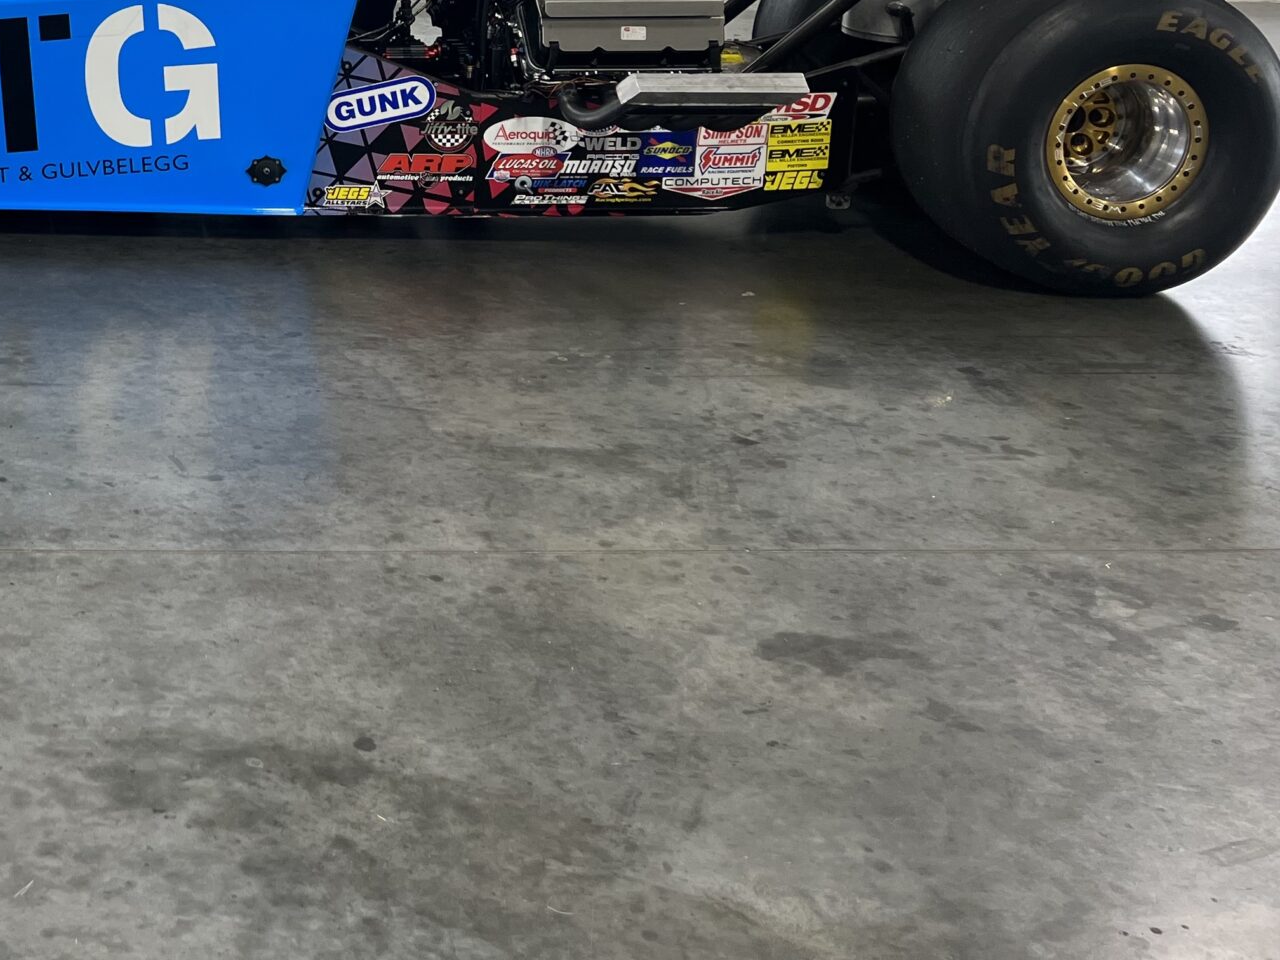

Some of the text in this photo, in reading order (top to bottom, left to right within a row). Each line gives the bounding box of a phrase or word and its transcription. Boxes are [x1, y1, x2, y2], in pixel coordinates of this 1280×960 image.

[1156, 10, 1262, 83] EAGLE
[334, 86, 423, 122] GUNK
[421, 123, 479, 135] Jiffy-tite
[494, 123, 557, 142] Aeroquip
[702, 125, 764, 139] SIMPSON
[770, 122, 819, 134] BME
[585, 137, 642, 151] WELD
[644, 145, 691, 155] SUNOCO
[535, 147, 554, 156] NHRA
[768, 147, 818, 159] BME
[18, 164, 33, 182] &
[40, 154, 190, 180] GULVBELEGG
[379, 153, 472, 172] ARP
[498, 159, 557, 169] LUCAS OIL
[560, 160, 637, 173] MOROSO
[664, 176, 762, 186] COMPUTECH
[764, 170, 824, 191] JEGS
[326, 186, 370, 200] JEGS
